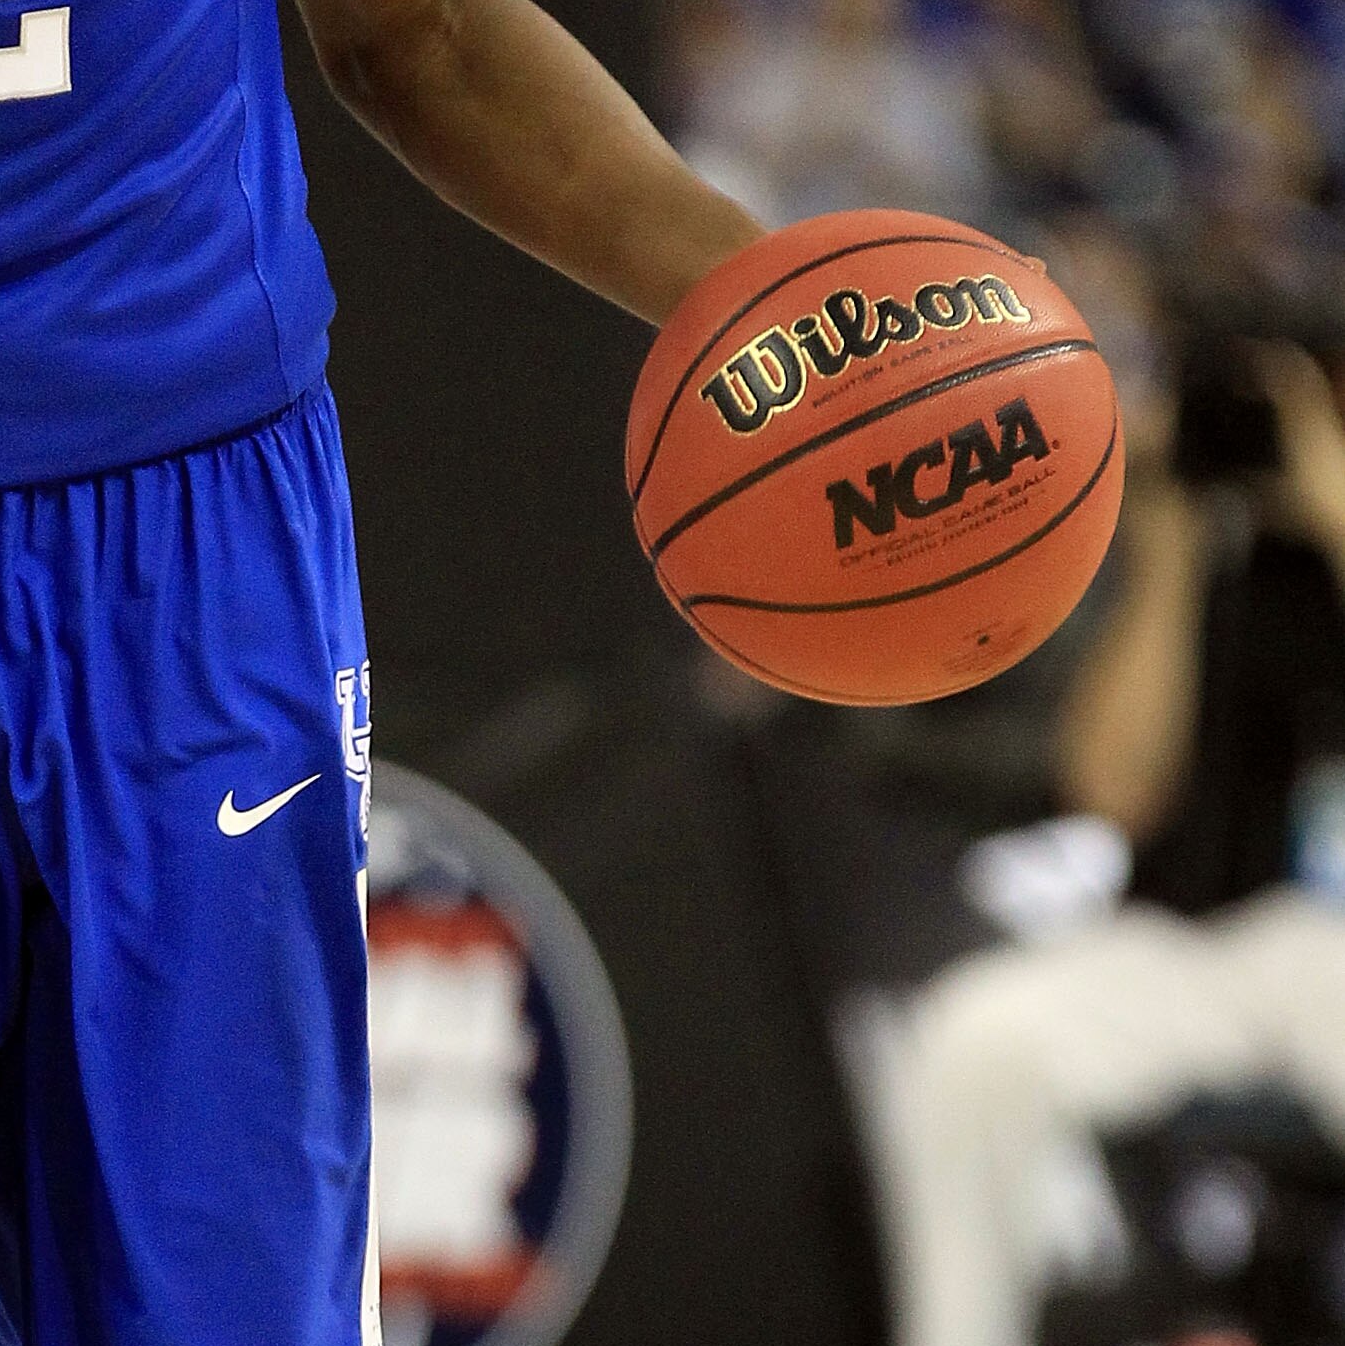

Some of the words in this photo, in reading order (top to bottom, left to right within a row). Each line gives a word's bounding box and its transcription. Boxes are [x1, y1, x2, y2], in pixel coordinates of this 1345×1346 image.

[699, 274, 1032, 436] Wilson
[826, 397, 1054, 549] NCAA
[1008, 468, 1056, 497] BALL
